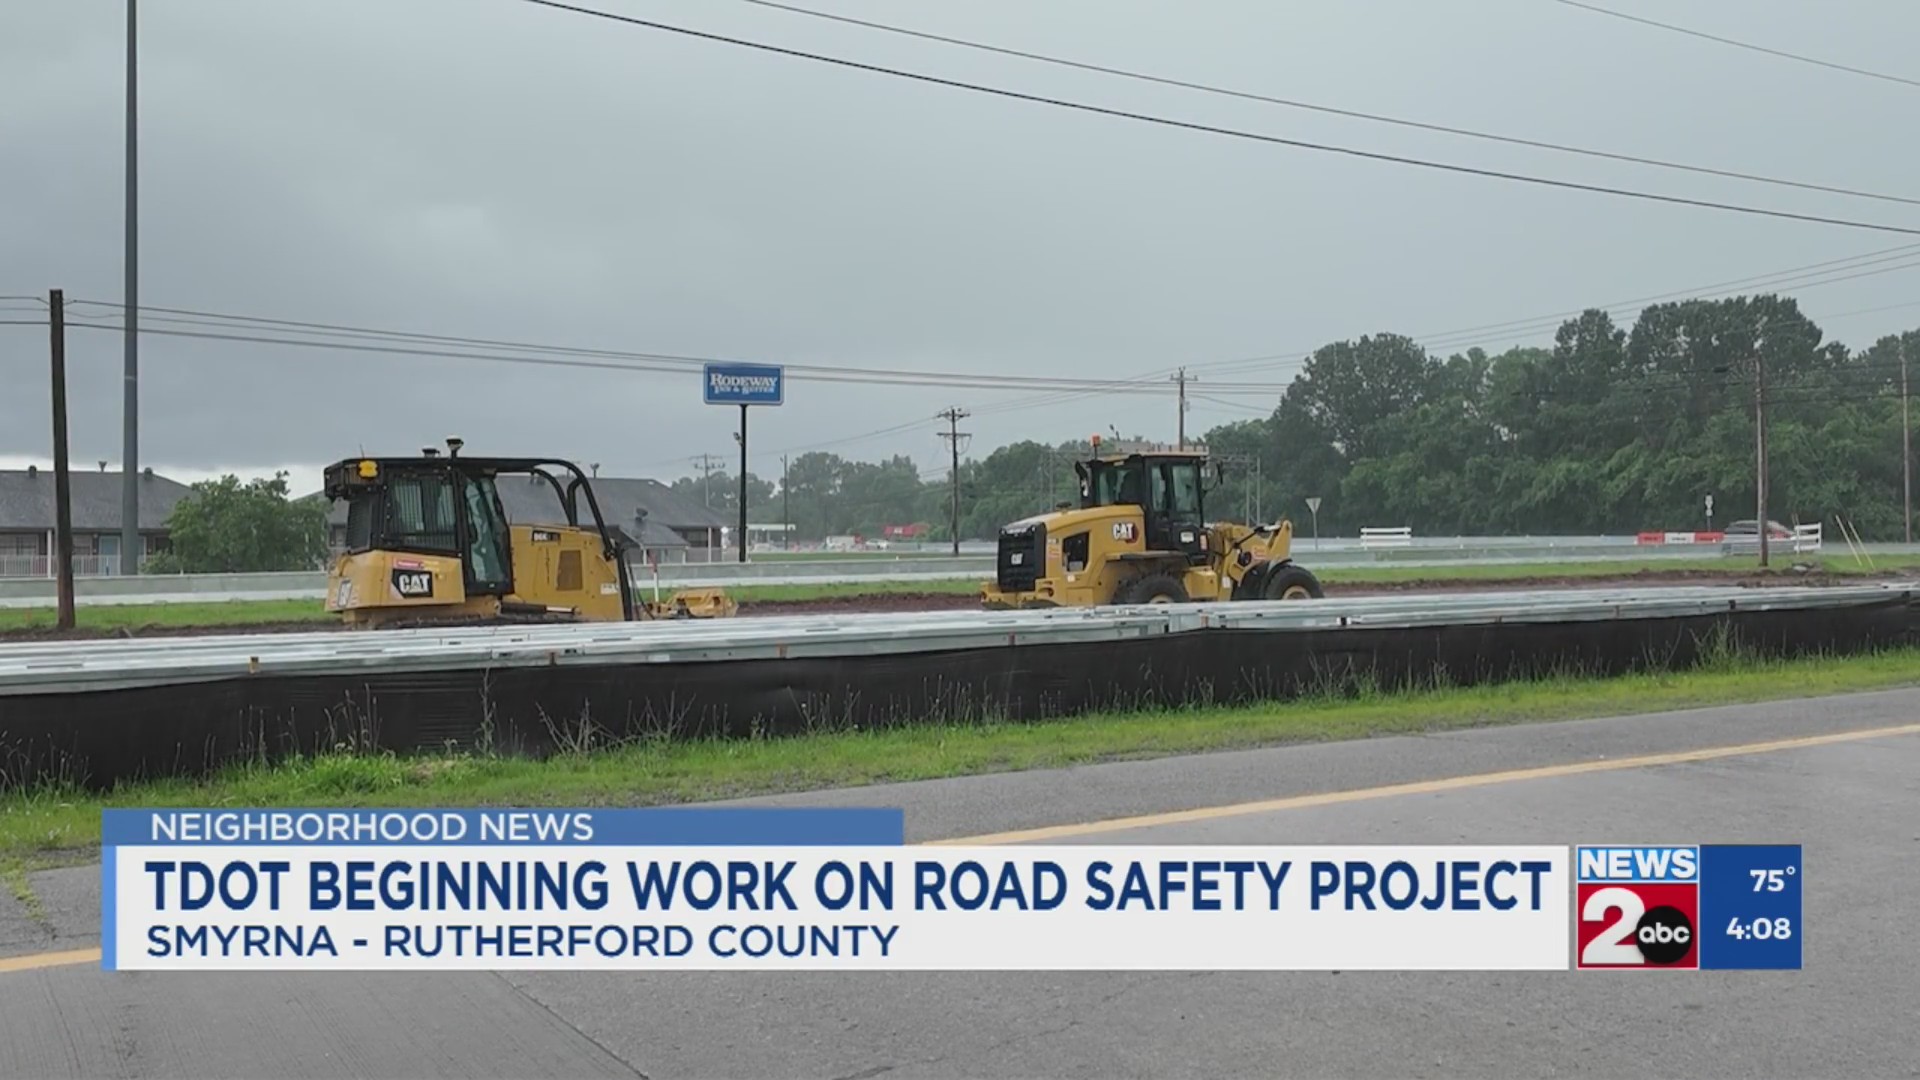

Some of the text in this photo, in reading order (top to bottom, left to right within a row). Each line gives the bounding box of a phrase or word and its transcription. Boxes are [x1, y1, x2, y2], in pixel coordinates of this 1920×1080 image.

[710, 373, 777, 386] RODEWAY
[1112, 522, 1134, 540] CAT
[1010, 552, 1023, 565] CAT
[398, 573, 431, 594] CAT
